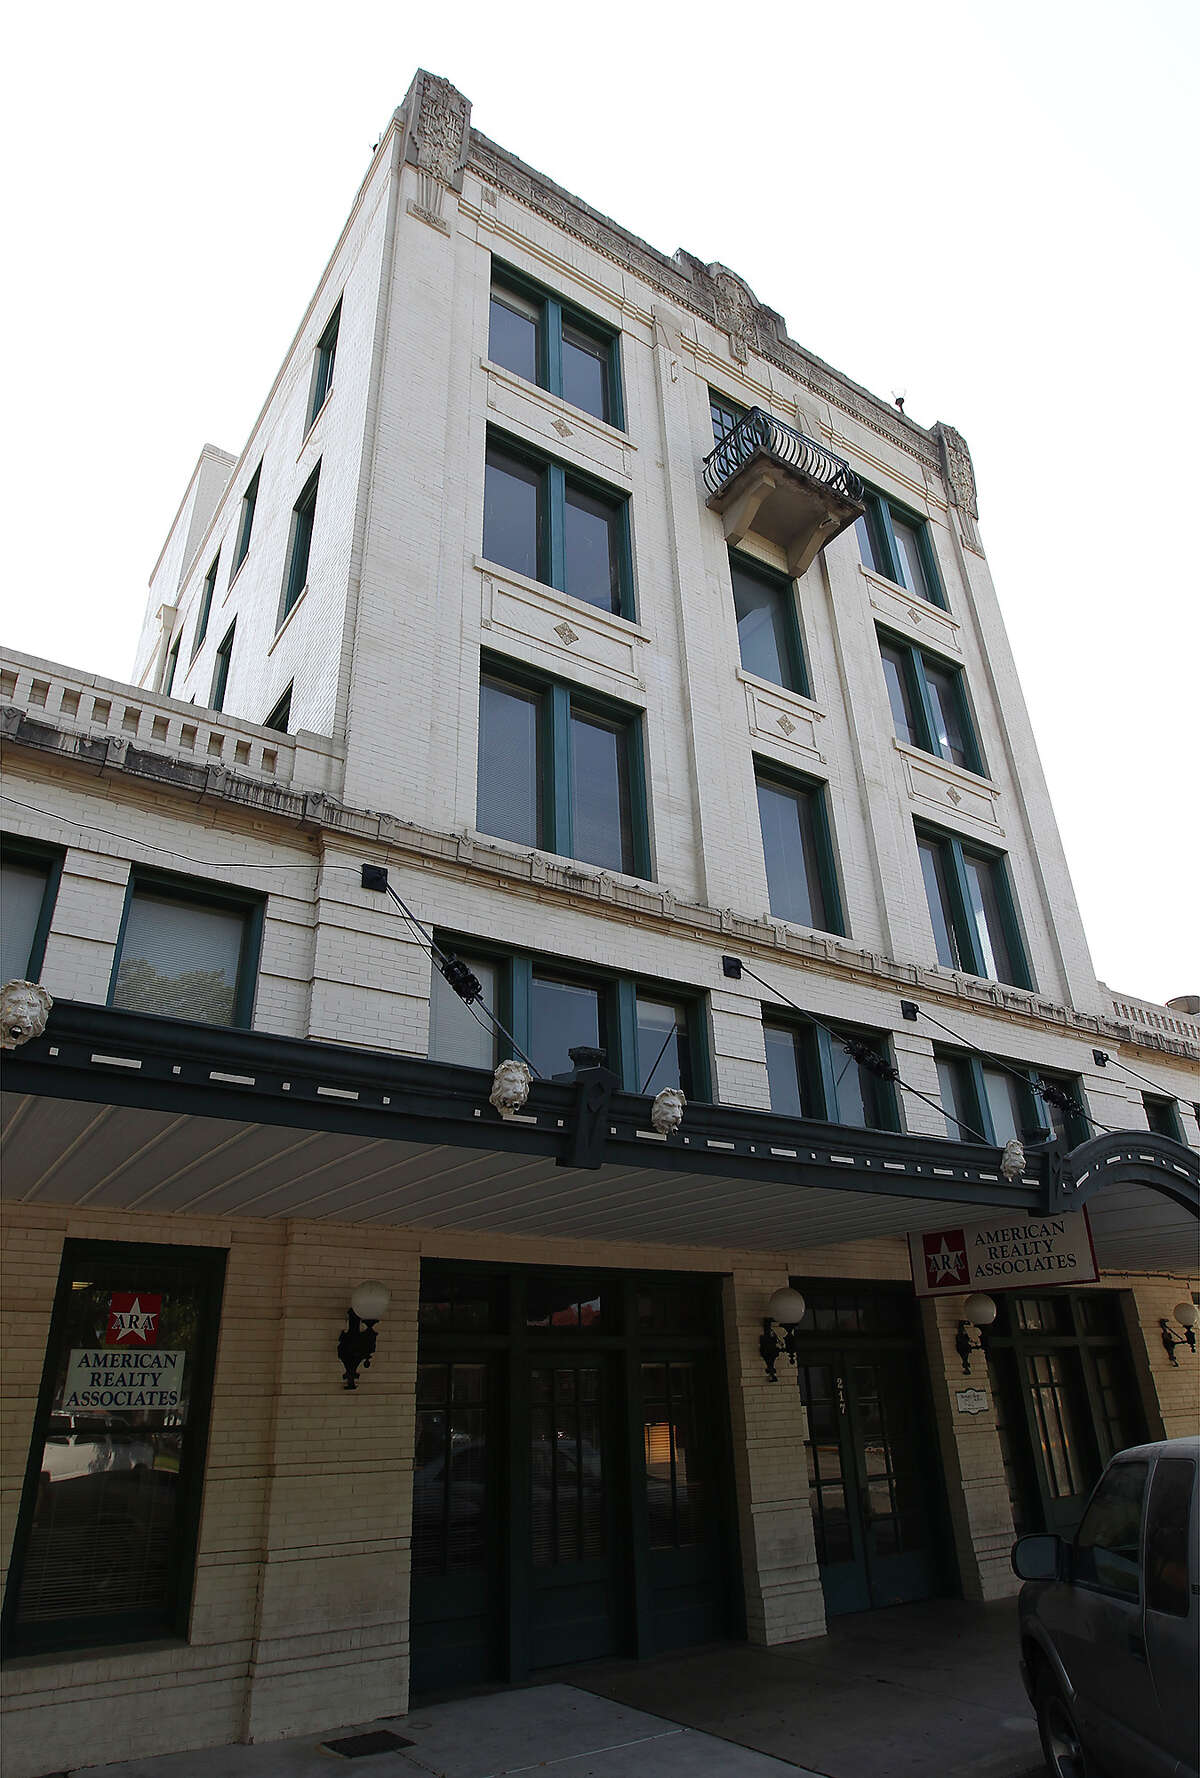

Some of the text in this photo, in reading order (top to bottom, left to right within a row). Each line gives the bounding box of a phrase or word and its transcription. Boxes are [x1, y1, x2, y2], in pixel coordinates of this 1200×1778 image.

[975, 1220, 1065, 1247] AMERICAN
[987, 1238, 1055, 1260] REALTY
[929, 1252, 965, 1273] ARA
[974, 1253, 1077, 1278] ASSOCIATES
[111, 1314, 155, 1331] ARA
[78, 1353, 177, 1369] AMERICAN
[89, 1372, 162, 1387] REALTY
[66, 1390, 178, 1407] ASSOCIATES
